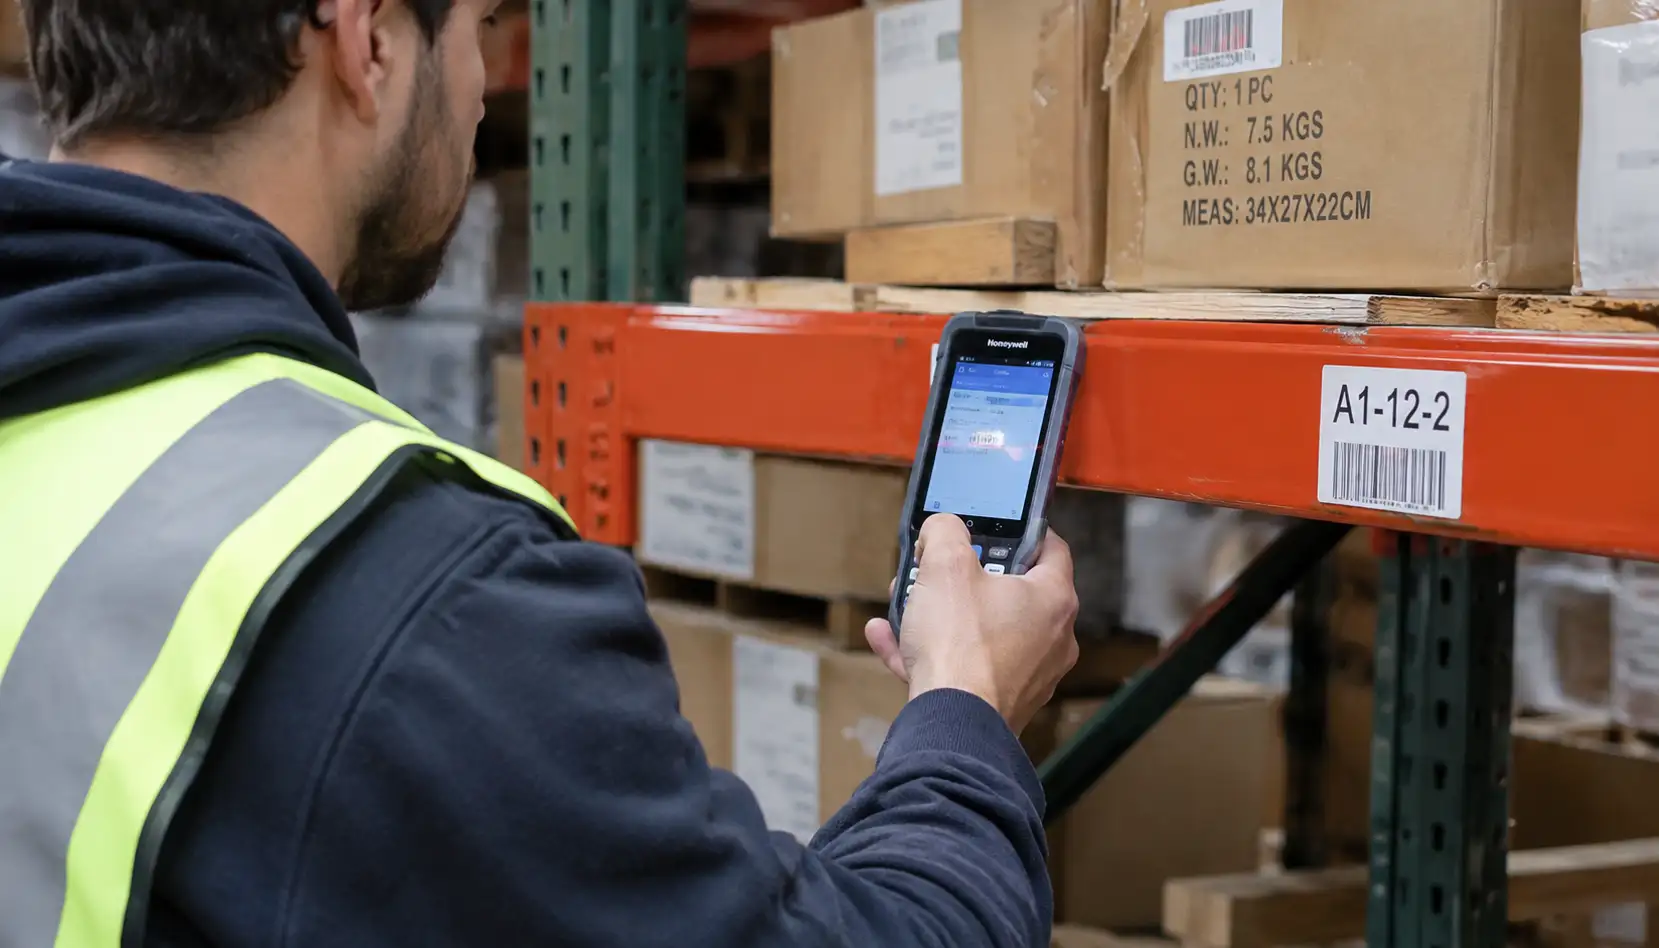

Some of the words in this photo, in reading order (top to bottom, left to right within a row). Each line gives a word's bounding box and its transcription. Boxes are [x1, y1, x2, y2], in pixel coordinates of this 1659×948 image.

[1185, 80, 1227, 111] QTY:
[1234, 78, 1242, 106] 1
[1248, 75, 1273, 105] PC
[1184, 120, 1229, 149] N.W.:
[1247, 115, 1273, 144] 7.5
[1282, 110, 1324, 141] KGS
[1183, 158, 1229, 187] G.W.:
[1246, 155, 1271, 184] 8.1
[1281, 151, 1323, 182] KGS
[1182, 197, 1239, 226] MEAS:
[1245, 190, 1371, 225] 34X27X22CM
[987, 338, 1029, 349] Honeywell
[1332, 384, 1450, 432] A1-12-2
